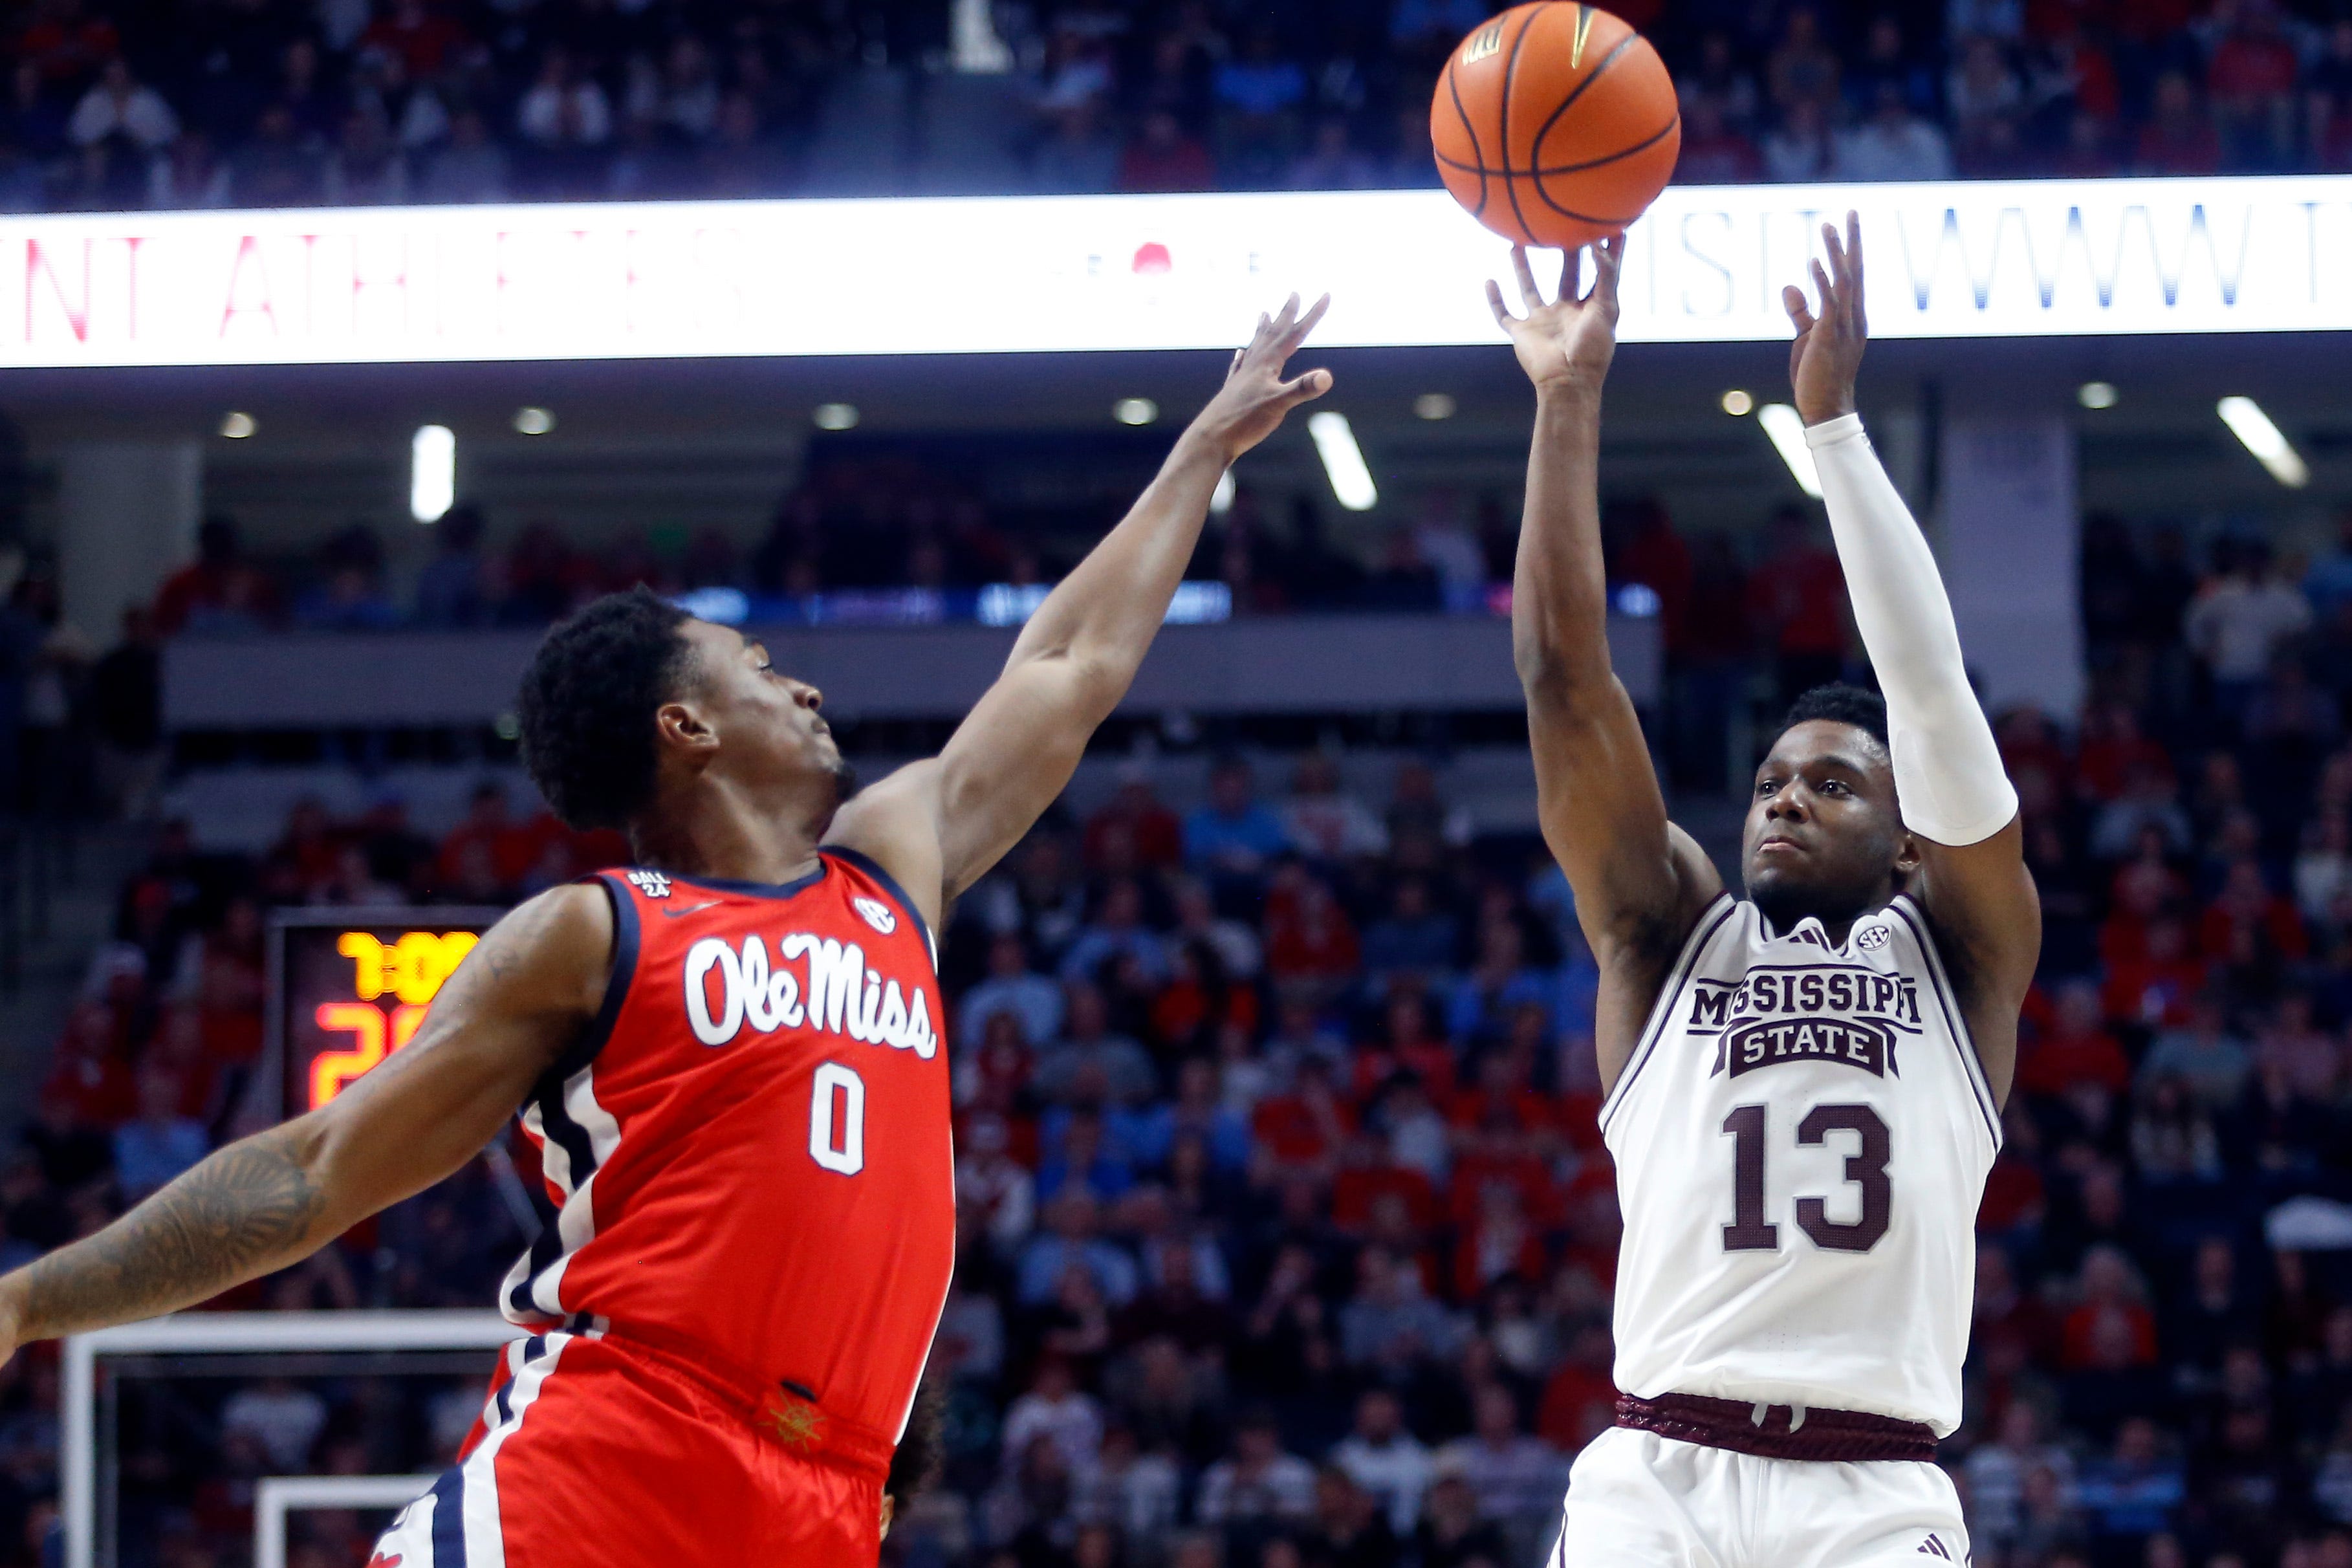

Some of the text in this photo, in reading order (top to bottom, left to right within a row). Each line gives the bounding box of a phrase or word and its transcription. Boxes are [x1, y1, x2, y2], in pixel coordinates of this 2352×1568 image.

[0, 234, 159, 346] NT
[1643, 208, 1834, 319] ISIT
[642, 883, 671, 898] 24
[1858, 926, 1889, 950] SEC
[684, 932, 938, 1060] Ole Miss
[1743, 1024, 1871, 1064] STATE
[809, 1060, 866, 1177] 0
[1718, 1102, 1893, 1254] 13
